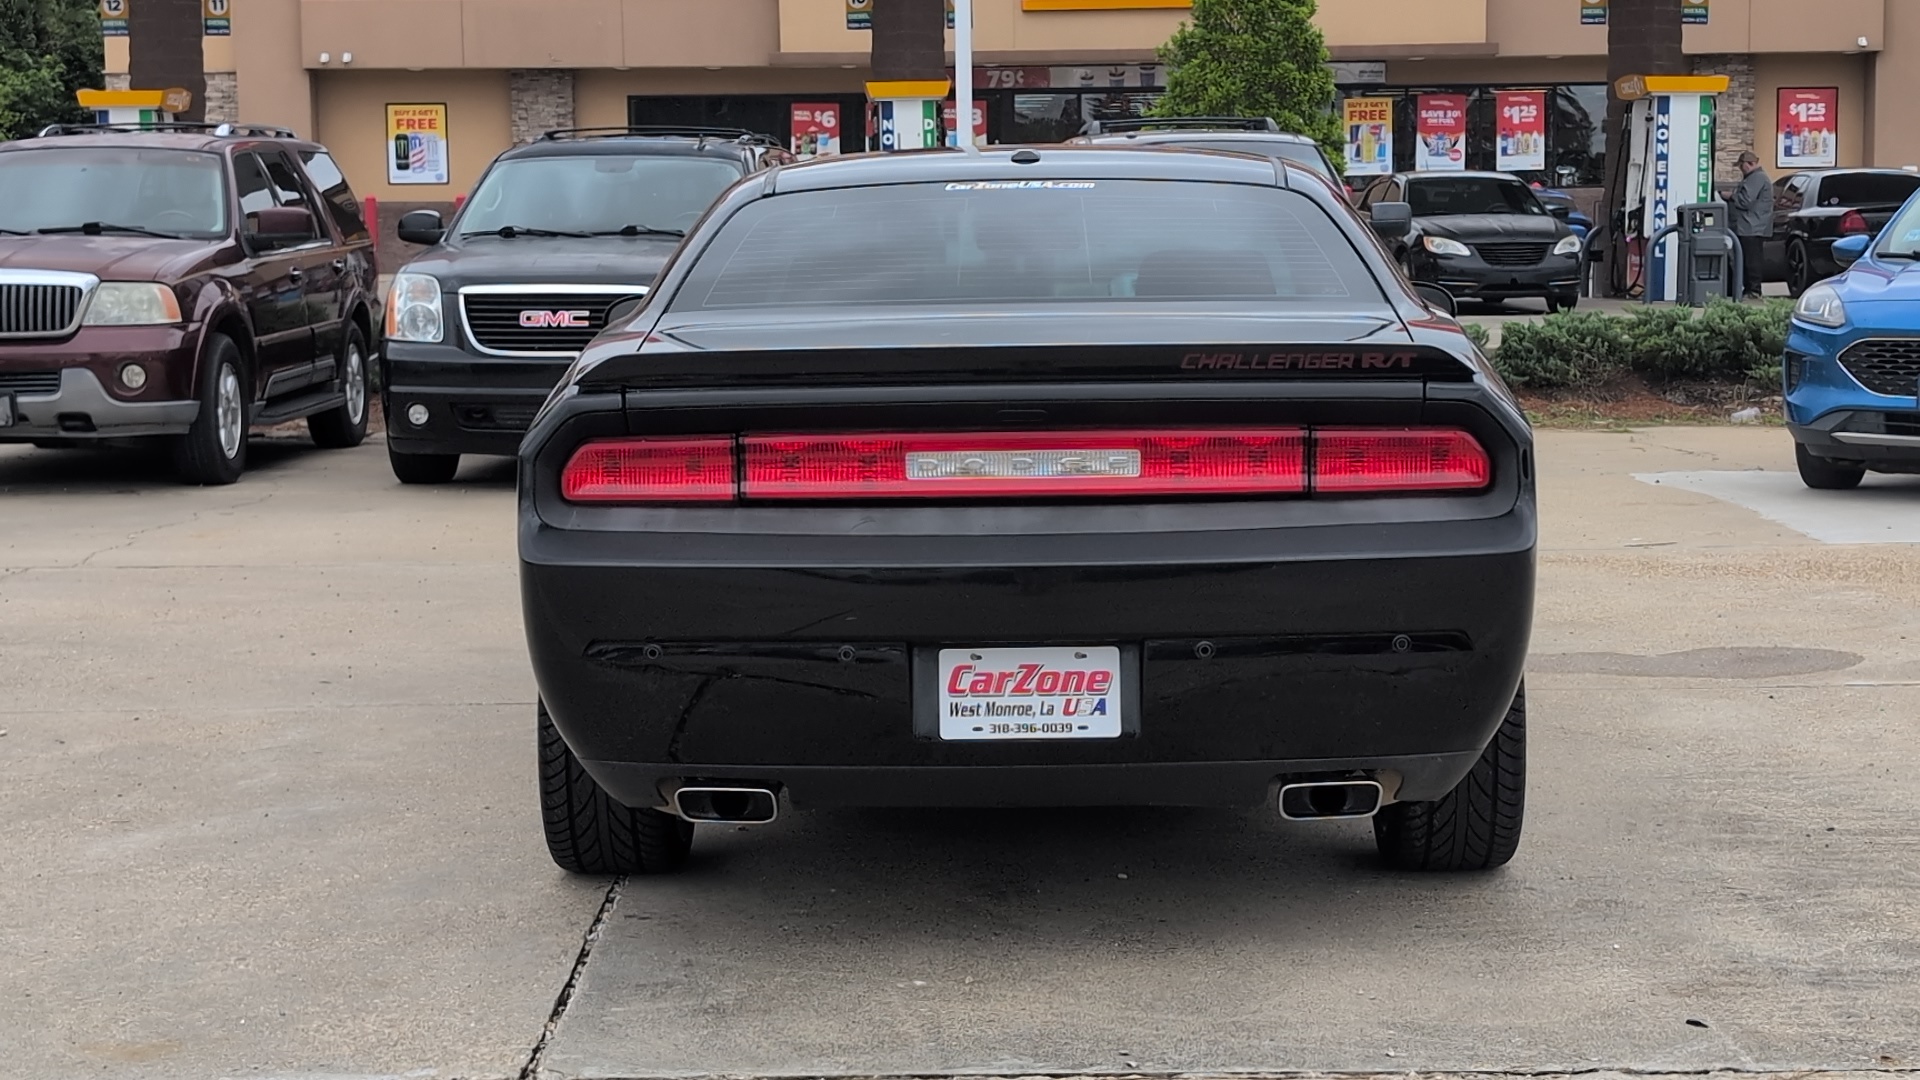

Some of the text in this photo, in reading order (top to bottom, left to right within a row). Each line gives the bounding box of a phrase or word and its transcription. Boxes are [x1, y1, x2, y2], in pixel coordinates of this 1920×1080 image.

[106, 0, 121, 11] 12
[211, 0, 224, 11] 11
[814, 110, 836, 128] $6
[1349, 109, 1387, 121] FREE
[1421, 110, 1444, 118] SAVE
[396, 118, 438, 130] FREE
[882, 119, 893, 146] NO
[1699, 115, 1710, 198] DIESEL
[945, 181, 1095, 190] CarZoneUSA.com
[1654, 114, 1669, 258] NON ETHANL
[519, 310, 590, 327] GMC
[1180, 352, 1418, 369] CHALLENGER R/T
[947, 663, 1113, 697] CarZone
[950, 700, 1055, 719] West Monroe, La
[1062, 697, 1108, 716] USA
[989, 722, 1073, 734] 318-396-0039
